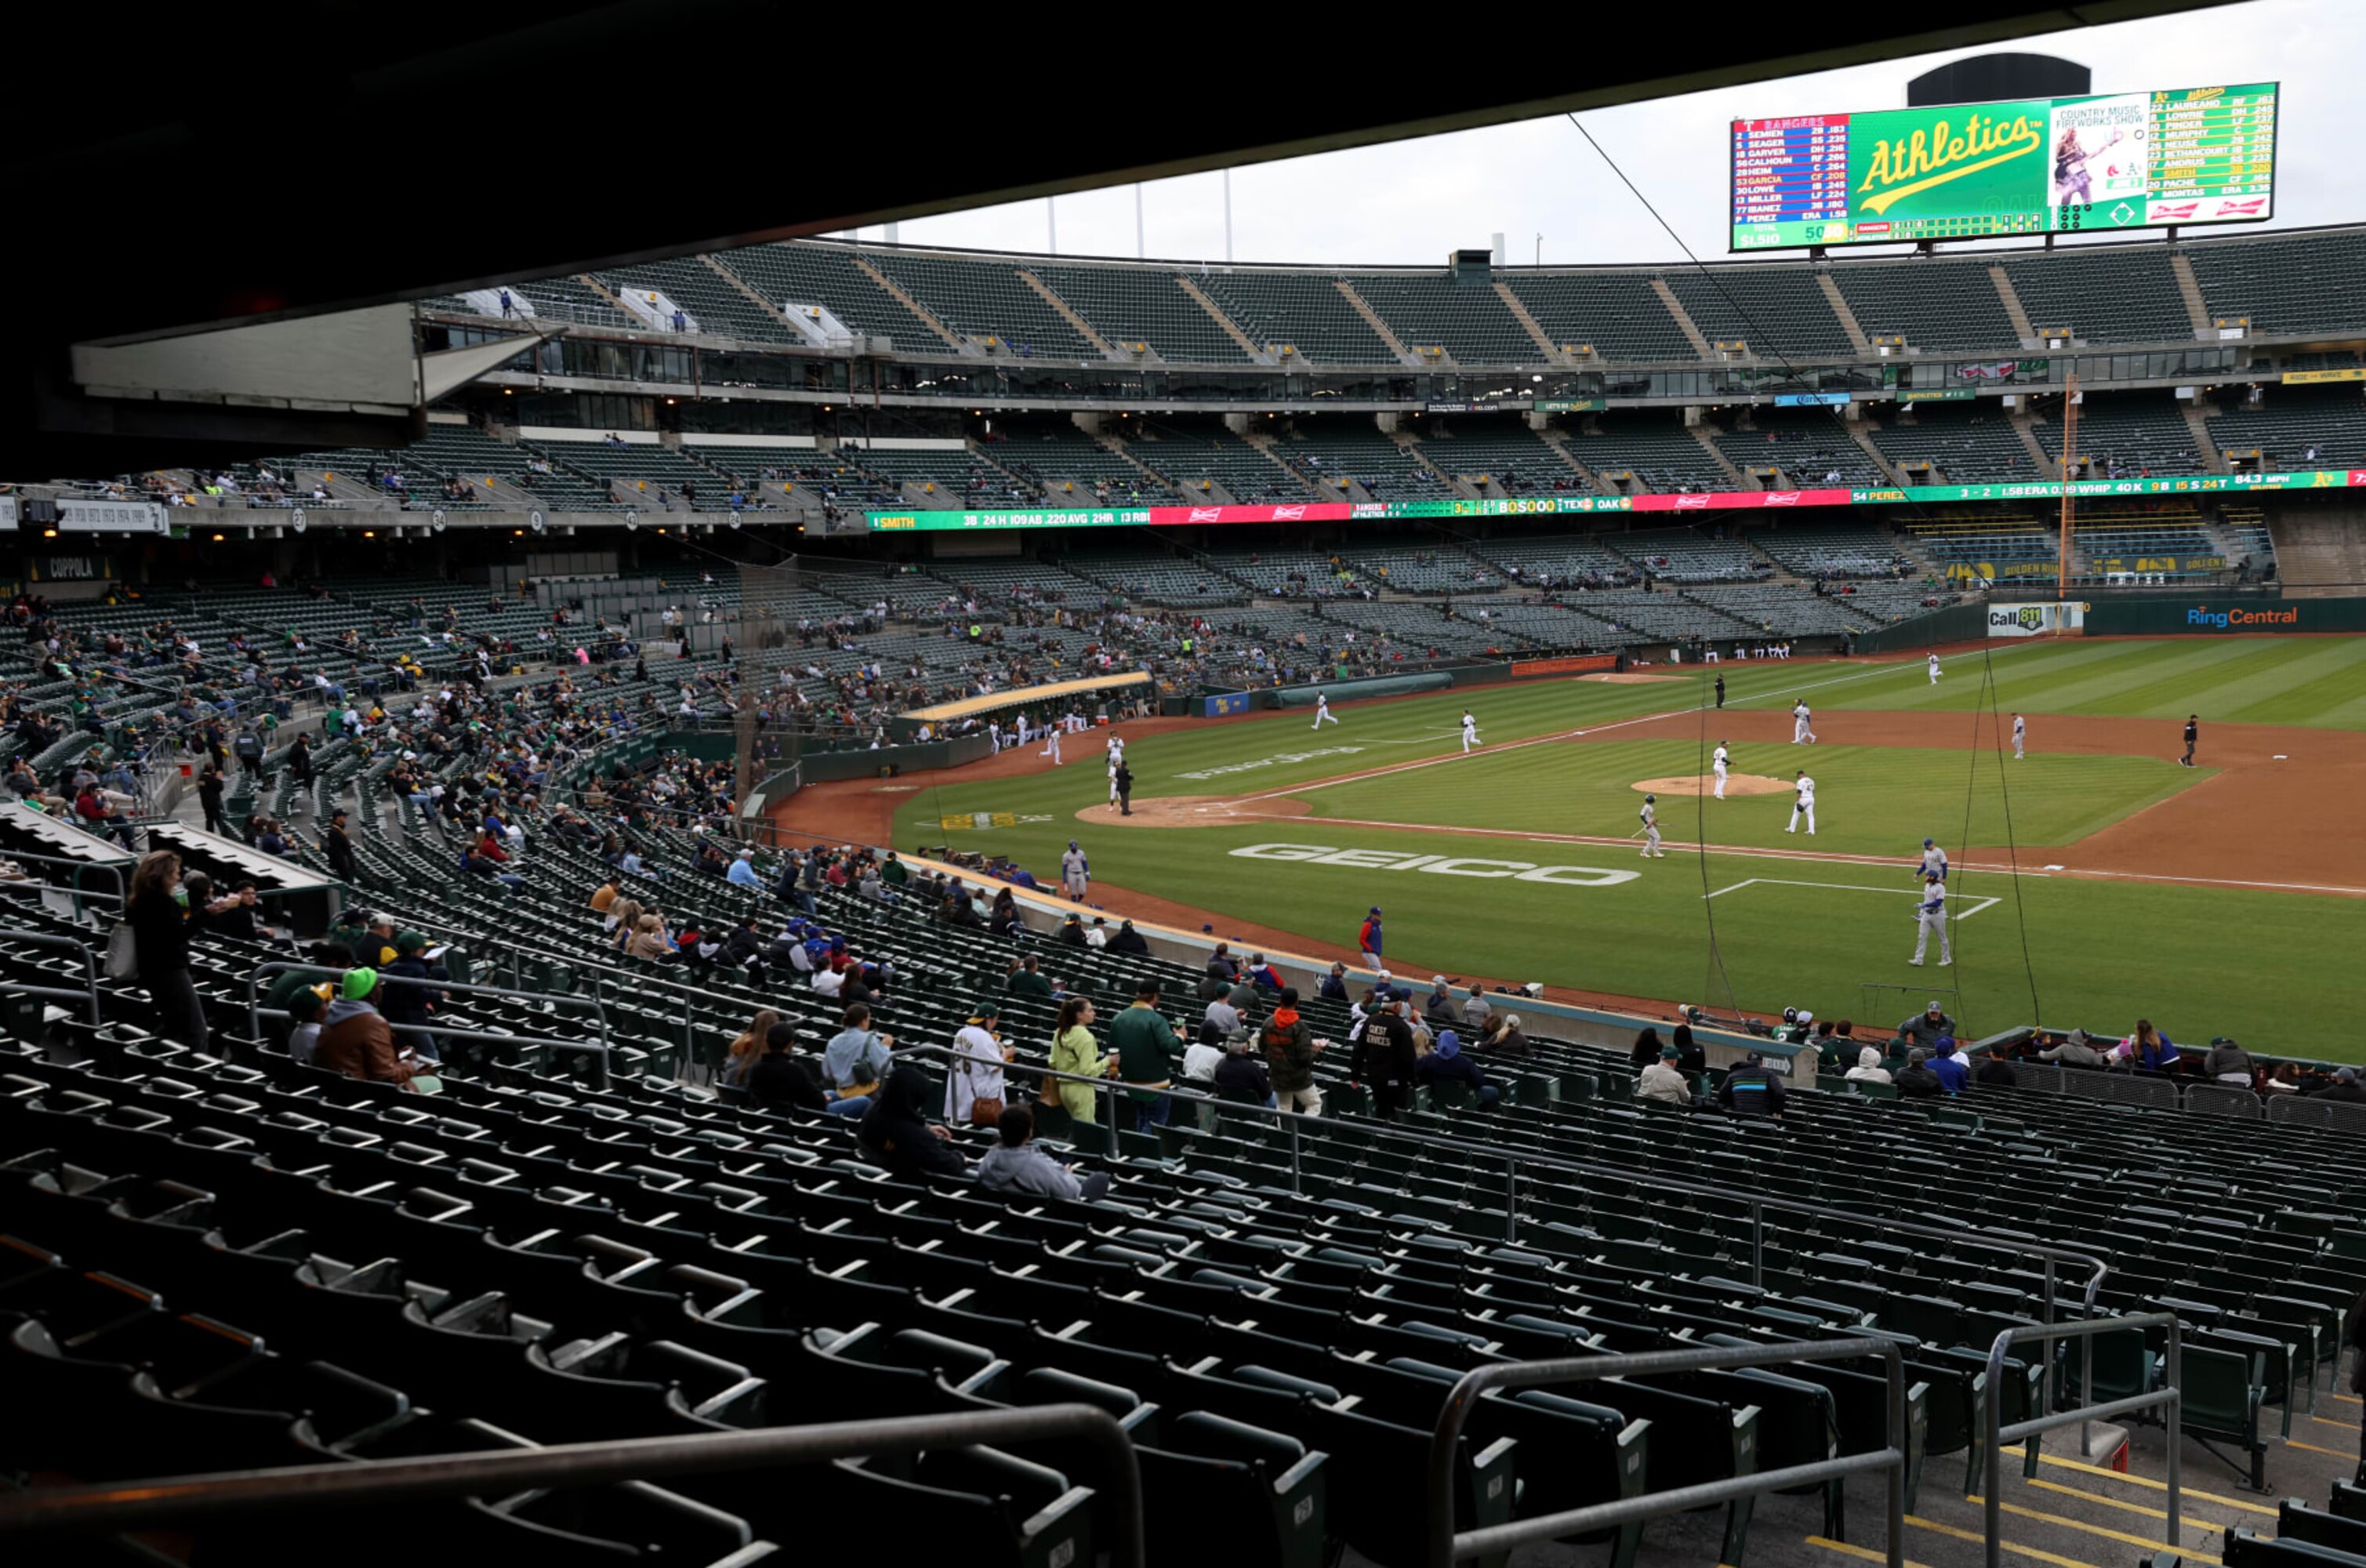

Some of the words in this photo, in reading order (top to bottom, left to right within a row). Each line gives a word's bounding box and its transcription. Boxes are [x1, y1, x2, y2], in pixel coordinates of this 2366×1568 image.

[2166, 99, 2220, 109] LAUREANO
[2061, 108, 2105, 120] COUNTRY
[2108, 105, 2140, 116] MUSIC
[2166, 111, 2205, 119] LOWRIE
[1765, 117, 1824, 130] RANGERS
[2056, 117, 2111, 129] FIREWORKS
[2114, 114, 2144, 125] SHOW
[2165, 120, 2202, 129] PINDER
[2103, 126, 2144, 142] ubo
[2165, 129, 2208, 138] MURPHY
[1857, 114, 2038, 196] Athletics
[2165, 147, 2229, 158] BETHANCOURT
[1748, 157, 1792, 166] CALHOUN
[2165, 158, 2205, 167] ANDRUS
[2162, 189, 2205, 198] MONTAS
[1747, 214, 1776, 223] PEREZ
[2235, 474, 2262, 484] 84.3
[1853, 492, 1867, 501] 54
[1869, 491, 1906, 500] PEREZ
[1961, 489, 1969, 498] 3
[1983, 488, 1990, 497] 2
[2001, 487, 2023, 495] 1.58
[2025, 486, 2048, 495] ERA
[2079, 485, 2111, 493] WHIP
[2116, 483, 2132, 492] 40
[2190, 481, 2200, 489] S
[2202, 480, 2218, 488] 24
[2218, 479, 2227, 488] T
[1455, 503, 1462, 514] 3
[1564, 499, 1582, 509] TEX
[1598, 499, 1619, 509] OAK
[294, 513, 304, 527] 27
[435, 514, 445, 527] 34
[730, 514, 739, 525] 24
[880, 517, 915, 528] SMITH
[963, 515, 977, 525] 3B
[983, 515, 996, 525] 24
[999, 515, 1007, 525] H
[1045, 514, 1065, 524] .220
[1067, 514, 1087, 524] AVG
[1121, 514, 1130, 522] 13
[1133, 513, 1150, 521] RBI
[50, 557, 93, 578] COPPOLA
[2005, 564, 2038, 575] GOLDEN
[2041, 563, 2059, 573] ROA
[1990, 612, 2017, 626] Call
[2019, 608, 2042, 622] 811
[2187, 606, 2297, 628] RingCentral
[1228, 844, 1642, 886] GEICO
[1369, 1025, 1388, 1036] GUEST
